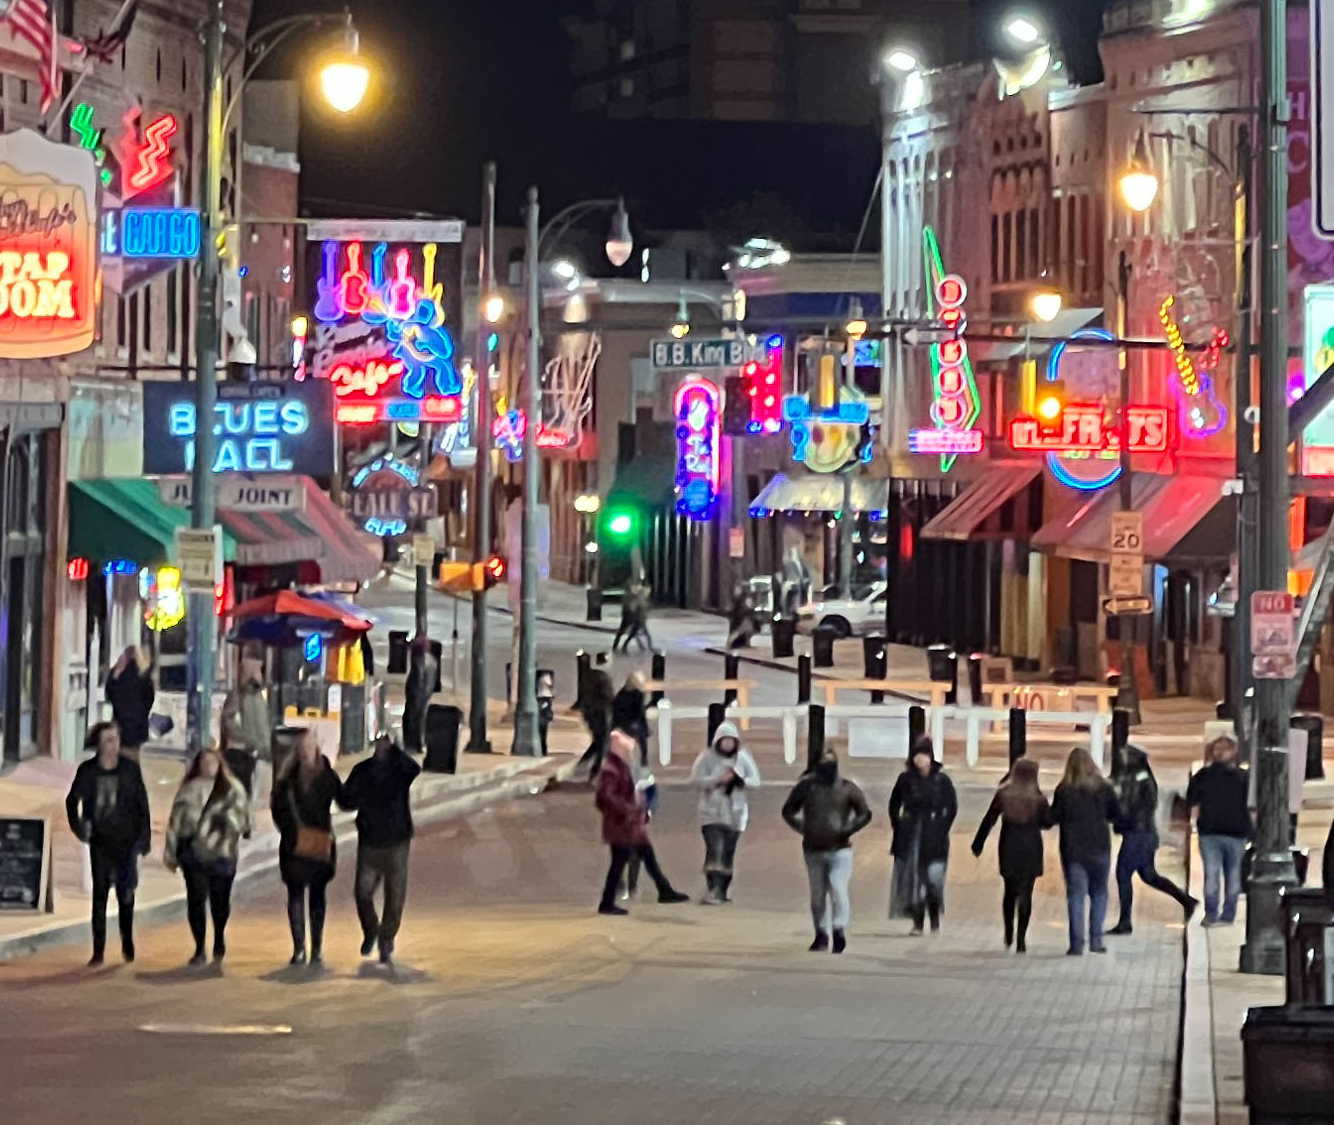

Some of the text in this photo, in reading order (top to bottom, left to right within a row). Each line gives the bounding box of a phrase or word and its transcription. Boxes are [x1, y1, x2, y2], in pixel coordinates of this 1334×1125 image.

[125, 212, 199, 255] CARGO
[169, 399, 309, 437] BUES
[236, 487, 294, 506] JOINT
[1113, 533, 1141, 549] 20
